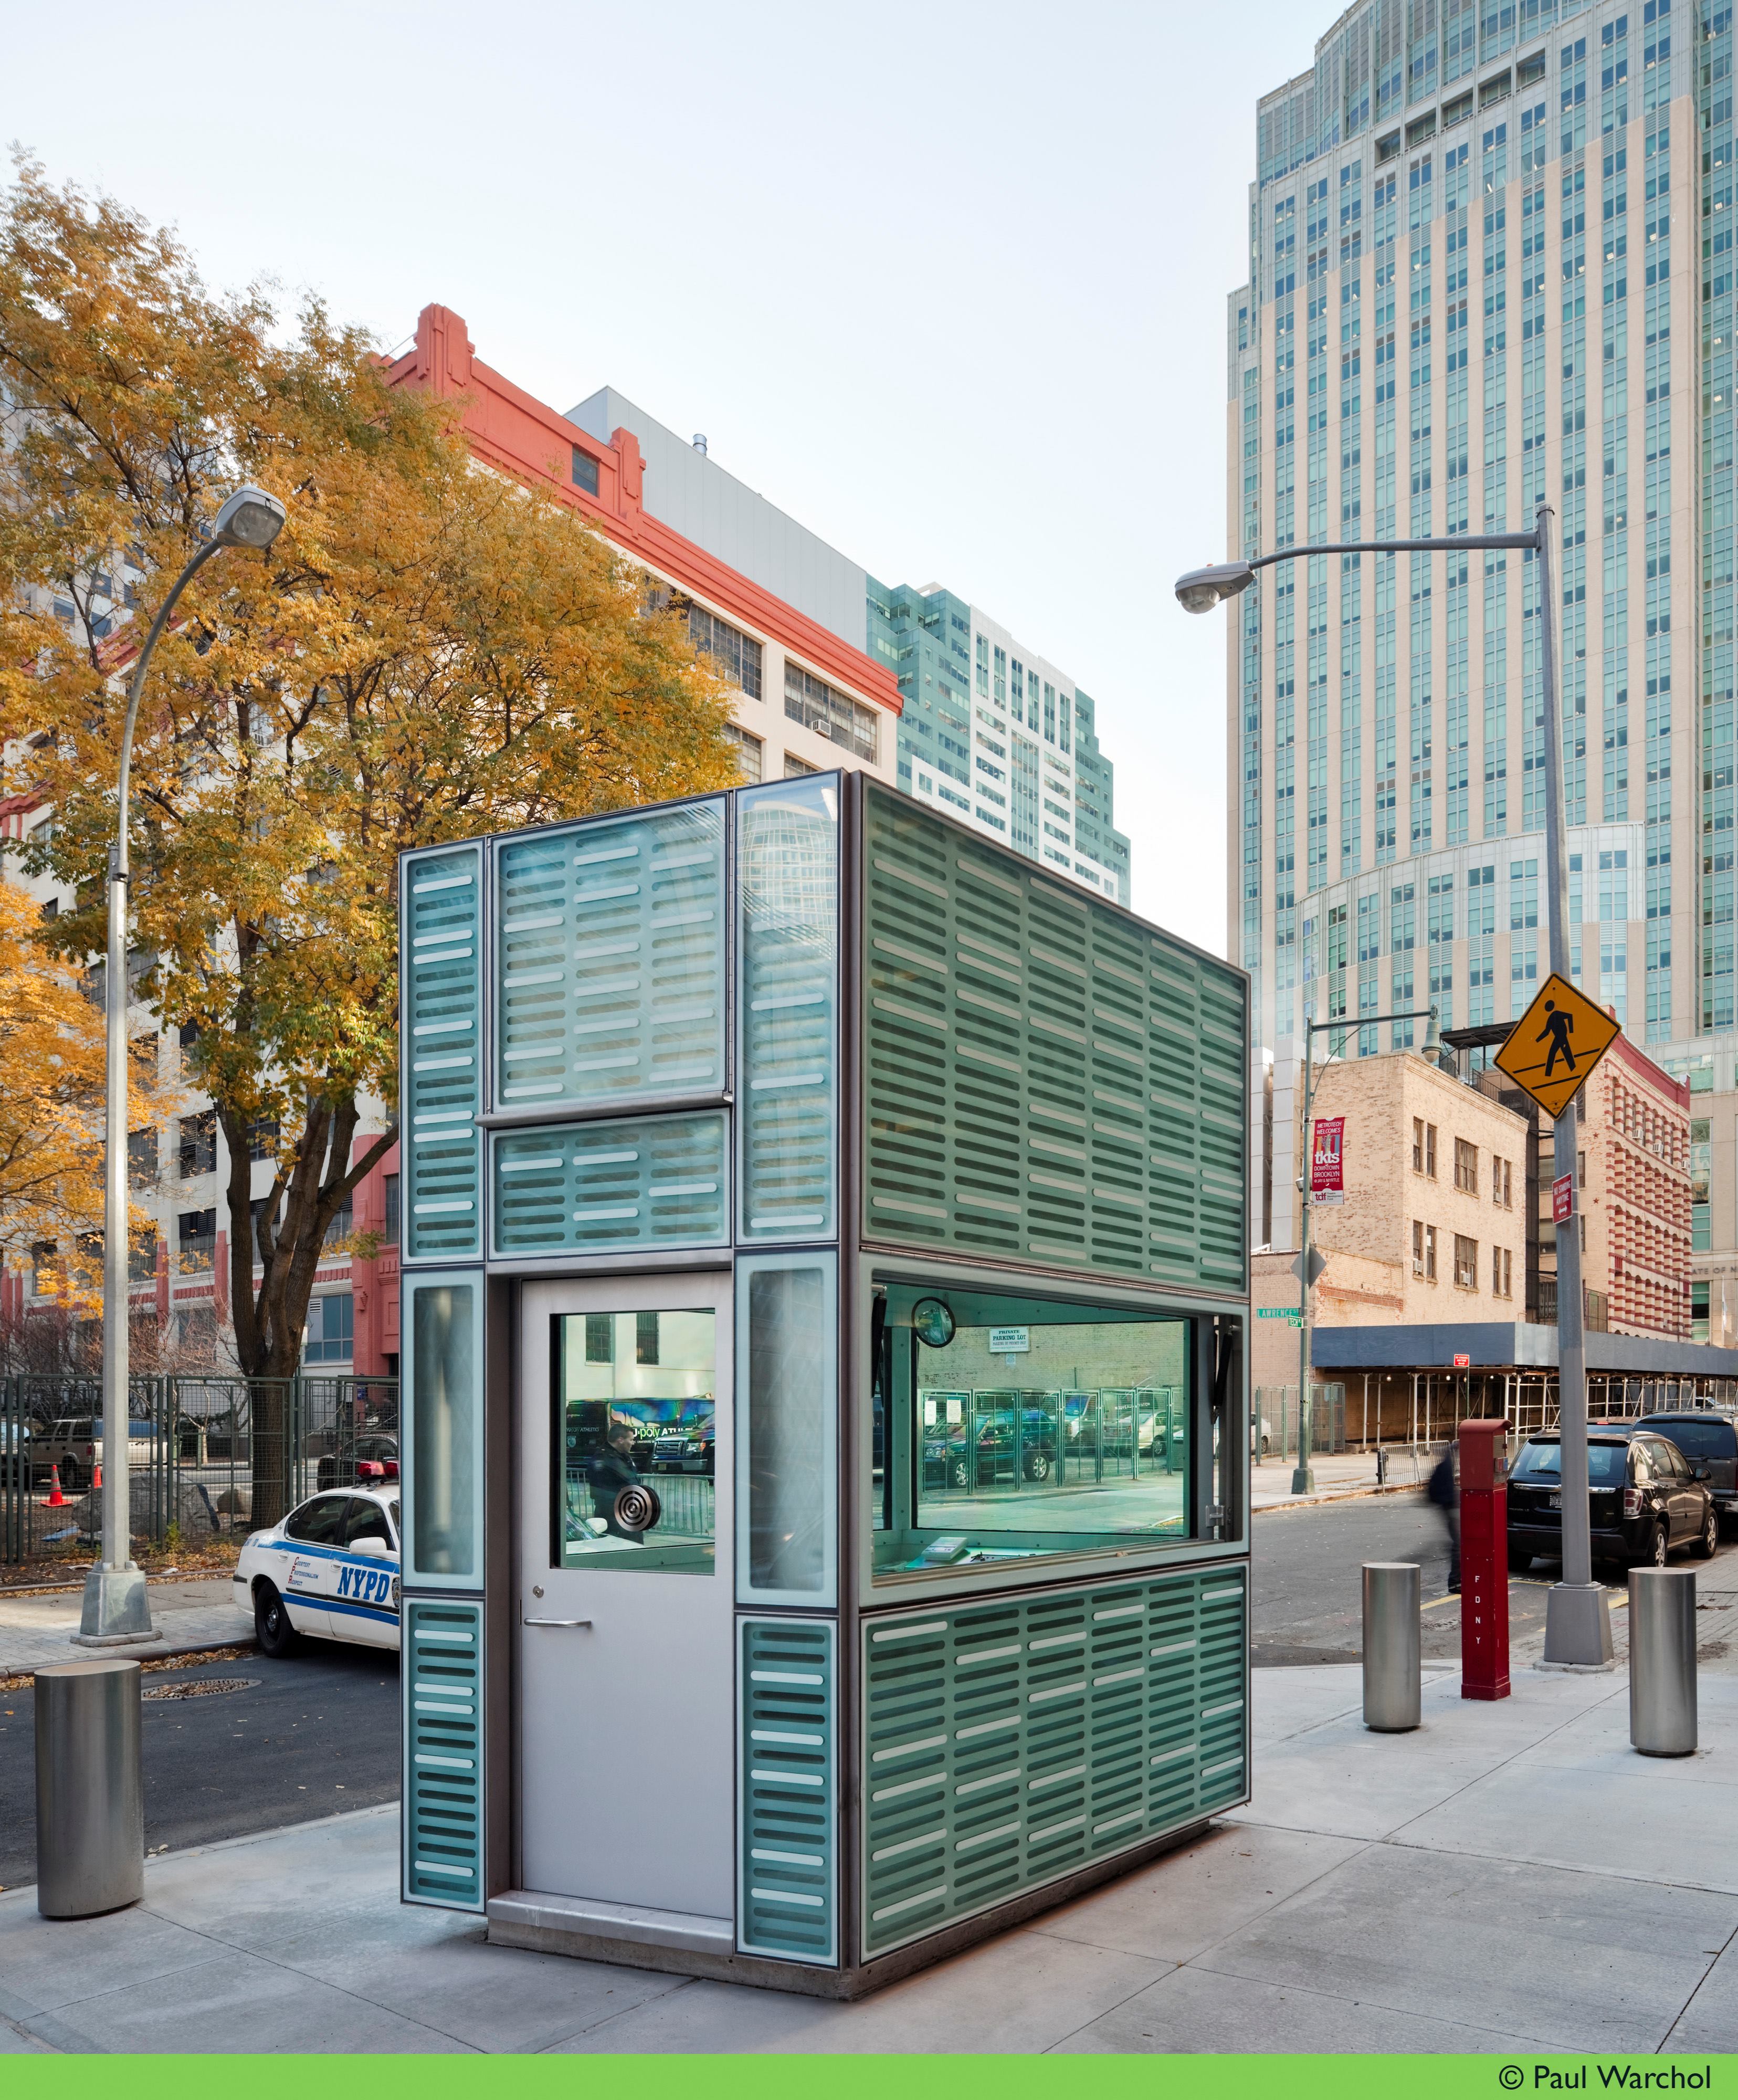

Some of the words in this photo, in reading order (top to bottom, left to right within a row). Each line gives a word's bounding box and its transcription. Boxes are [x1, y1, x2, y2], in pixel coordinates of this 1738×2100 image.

[1314, 1150, 1340, 1164] tkts
[1257, 1309, 1292, 1317] LAWRENCE
[1289, 1318, 1298, 1326] TECH
[288, 1576, 303, 1586] RESPECT
[337, 1567, 390, 1603] NYPD
